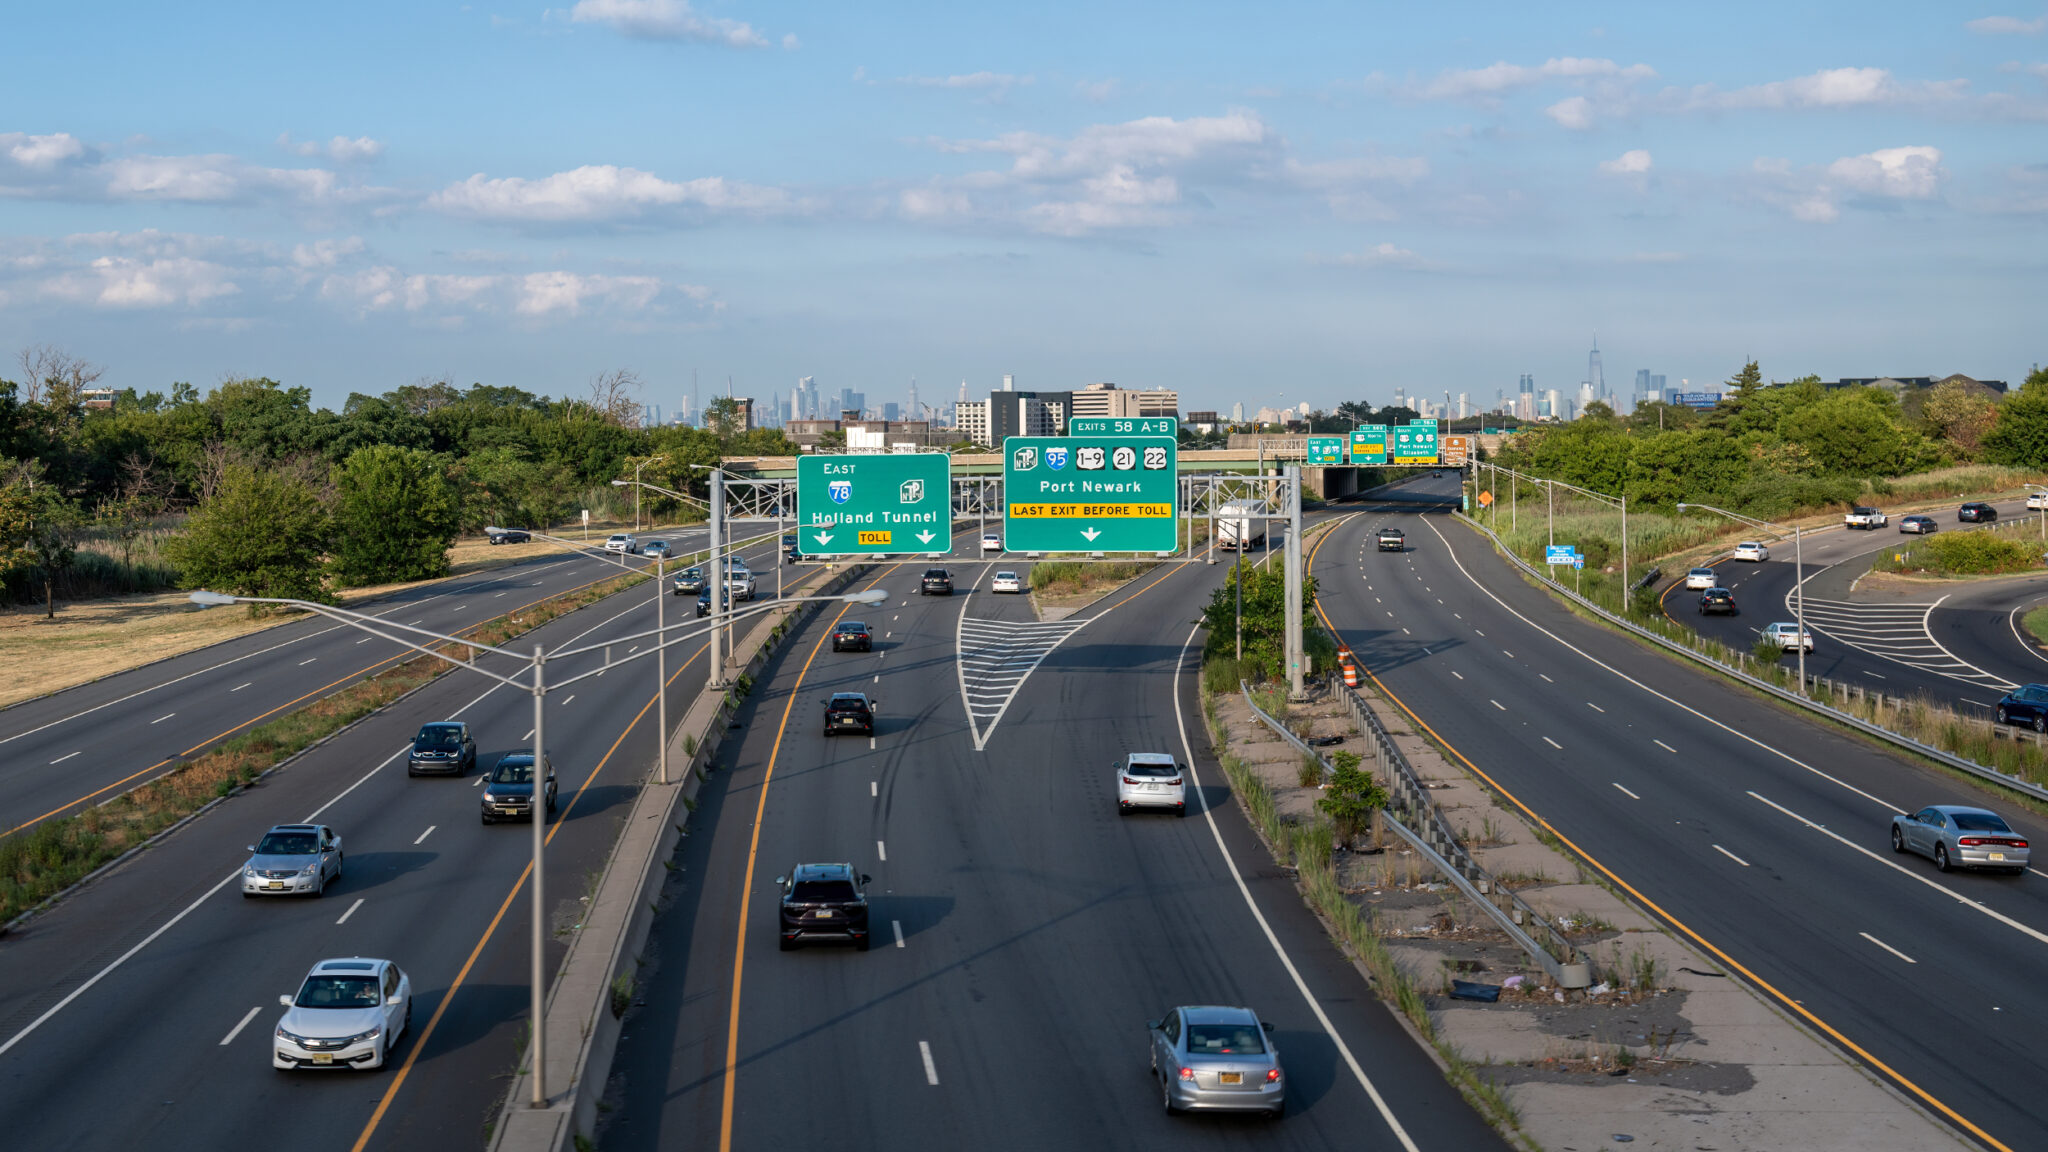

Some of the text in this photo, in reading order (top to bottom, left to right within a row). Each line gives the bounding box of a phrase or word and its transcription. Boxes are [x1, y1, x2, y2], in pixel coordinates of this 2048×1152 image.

[1078, 421, 1169, 432] EXITS 58 A-B
[1048, 453, 1066, 466] 95
[1080, 452, 1102, 465] 1-9
[1117, 452, 1130, 465] 21
[1146, 452, 1164, 465] 22
[823, 463, 856, 474] EAST
[831, 486, 849, 500] 78
[1040, 480, 1141, 493] Port Newark
[812, 511, 937, 524] Holland Tunnel
[1014, 506, 1167, 516] LAST EXIT BEFORE TOLL
[860, 533, 890, 543] TOLL
